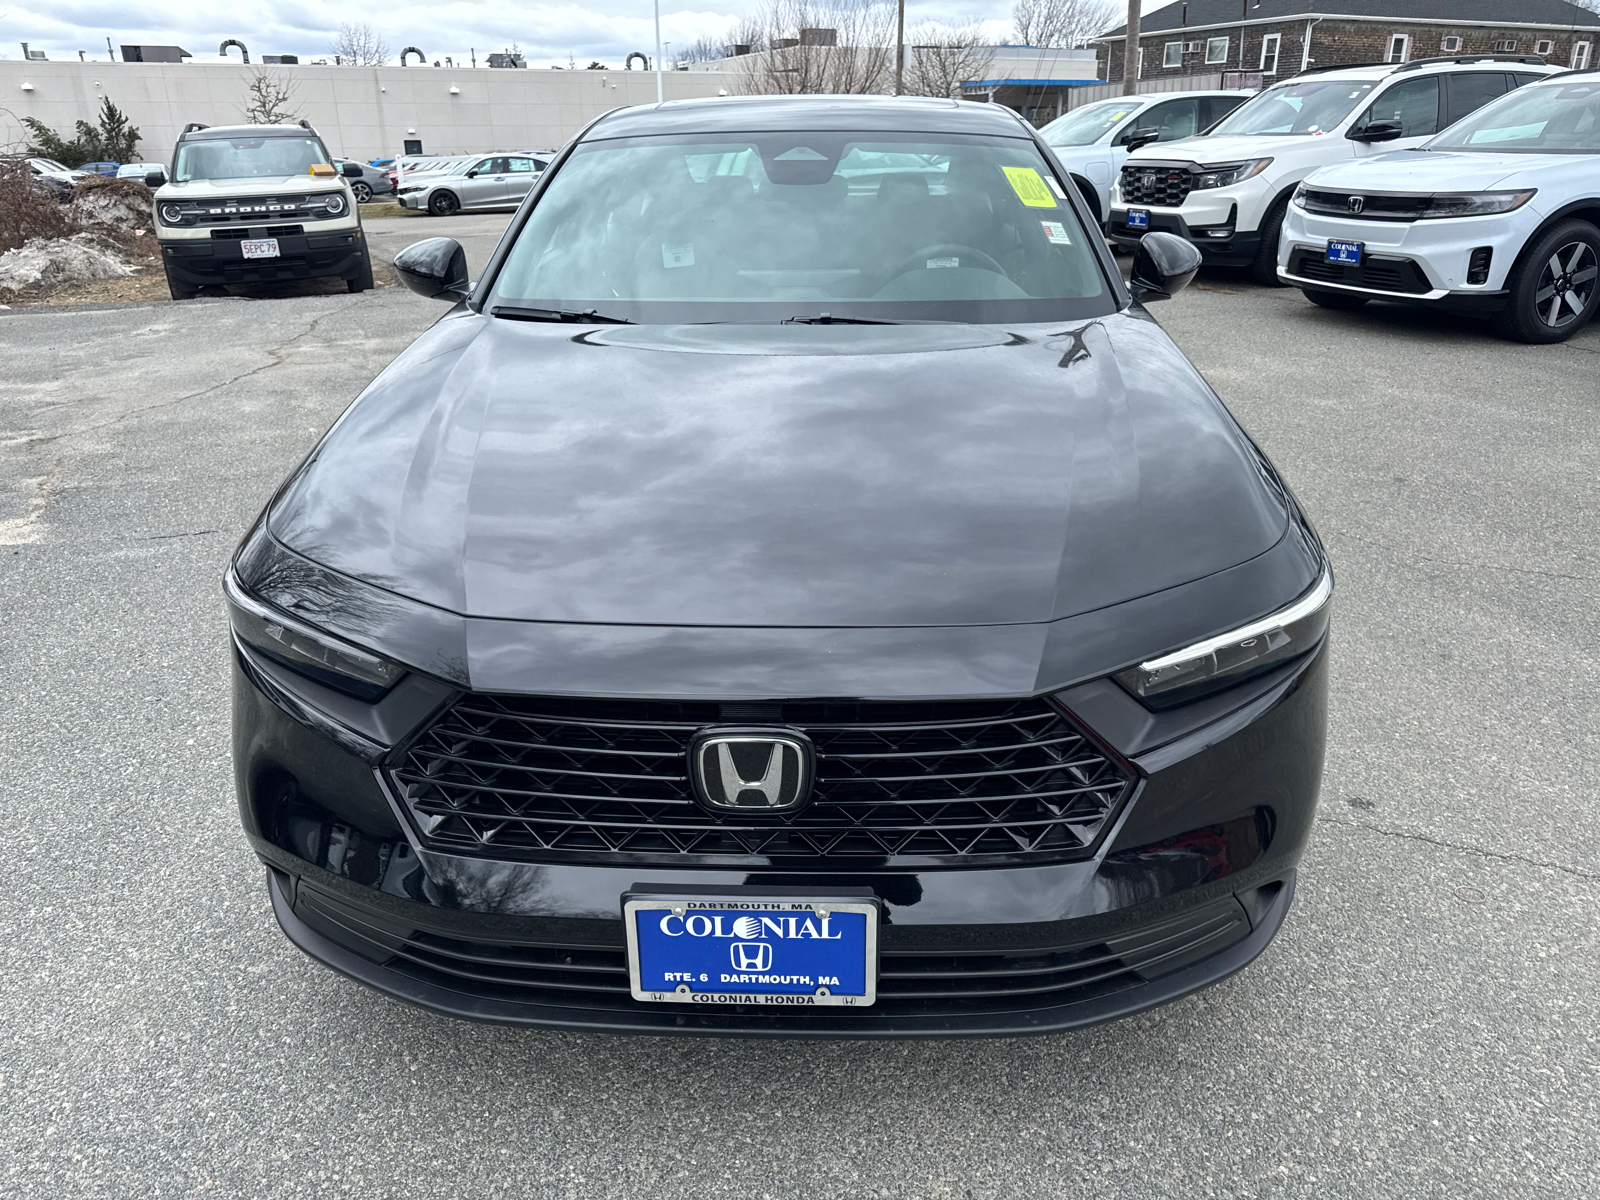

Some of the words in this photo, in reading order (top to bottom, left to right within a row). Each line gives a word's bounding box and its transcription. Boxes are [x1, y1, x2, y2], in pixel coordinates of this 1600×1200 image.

[209, 204, 296, 214] BRONCO
[243, 243, 265, 254] 5EPC
[266, 243, 277, 253] 79
[687, 902, 786, 911] DARTMOUTH,
[791, 903, 814, 911] MA
[659, 914, 842, 939] COLONIAL
[664, 972, 696, 982] RTE.
[699, 973, 709, 982] 6
[720, 973, 814, 986] DARTMOUTH,
[818, 976, 840, 986] MA
[691, 994, 761, 1004] COLONIAL
[764, 995, 816, 1005] HONDA
